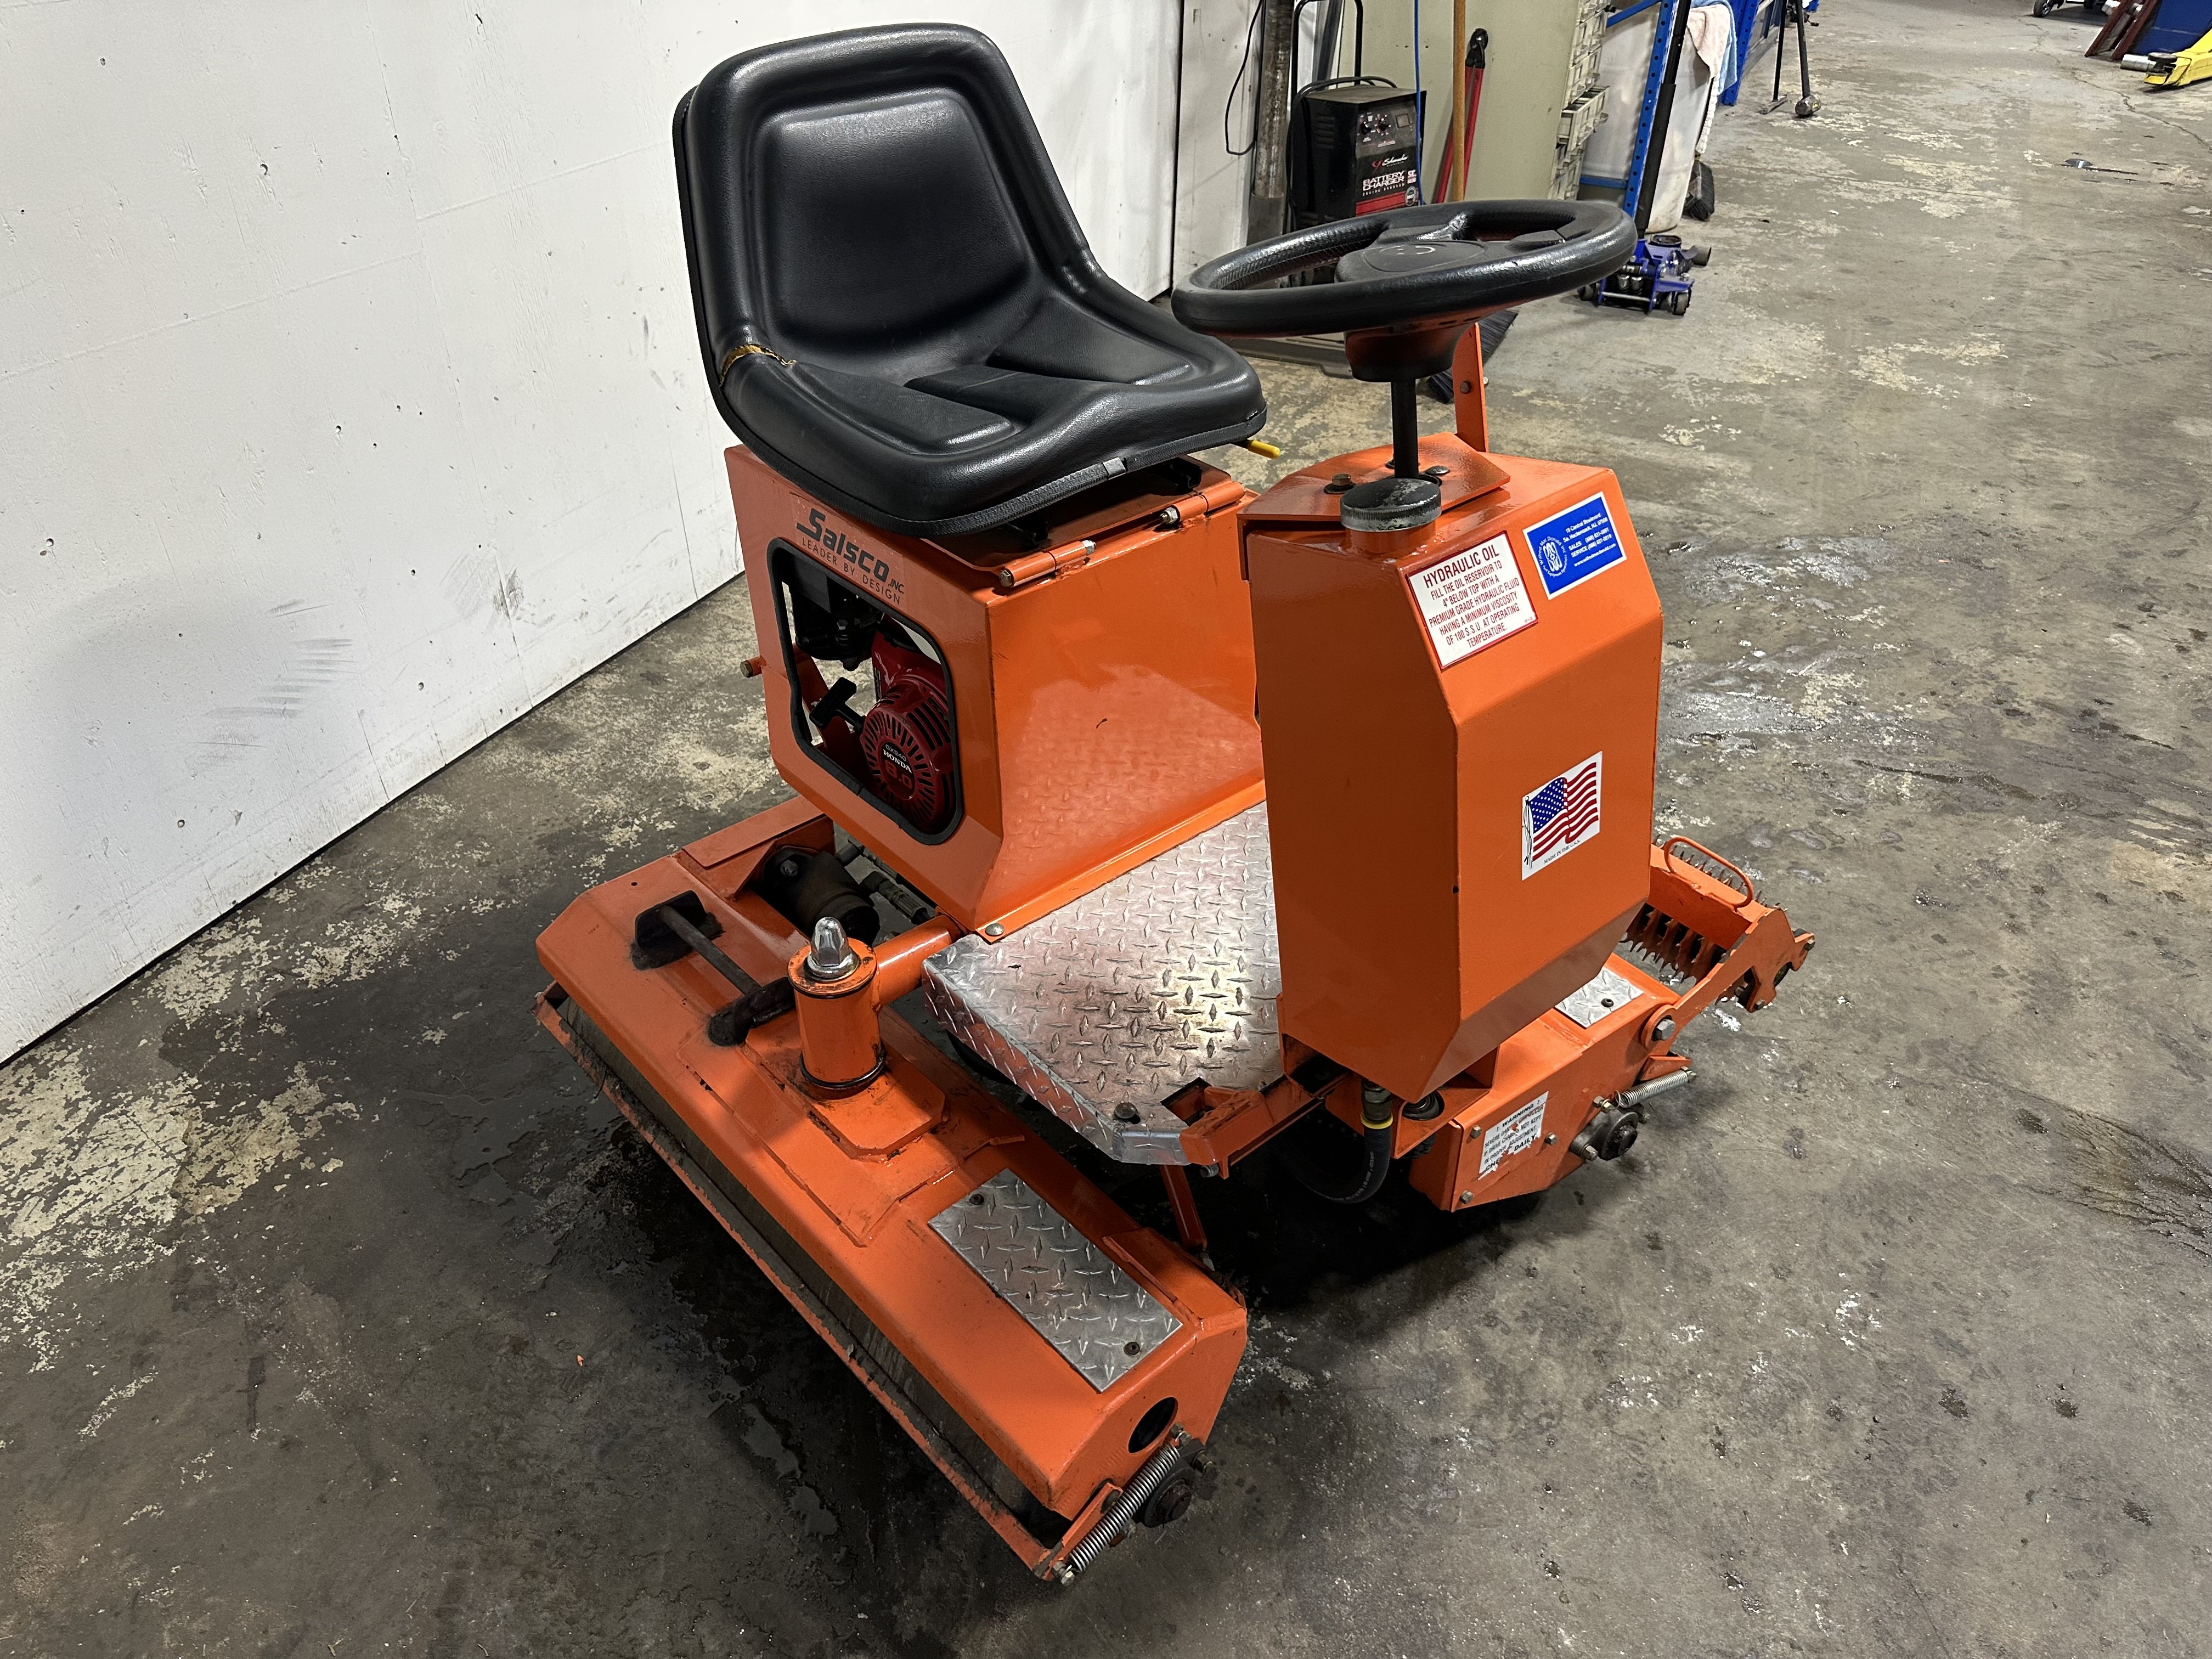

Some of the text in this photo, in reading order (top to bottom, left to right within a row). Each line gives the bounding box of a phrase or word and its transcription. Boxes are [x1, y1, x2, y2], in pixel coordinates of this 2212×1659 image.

[1363, 170, 1405, 186] BATTERY
[1363, 176, 1405, 191] CHARGER
[796, 508, 890, 583] Salsco
[1568, 540, 1582, 551] SALES
[1571, 545, 1588, 557] SERVICE
[802, 537, 900, 605] LEADER BY DESIGN
[1423, 544, 1499, 588] HYDRAULIC OIL
[1430, 560, 1502, 600] FILL THE OIL RESERVOIR TO
[1449, 589, 1469, 605] BELOW
[1469, 583, 1479, 595] TOP
[1480, 576, 1495, 590] WITH
[1495, 574, 1500, 583] A
[1429, 577, 1520, 628] PREMIUM GRADE HYDRAULIC FLUID
[1439, 591, 1518, 636] HAVING A MINIMUM VISCOSITY
[1446, 635, 1454, 646] OF
[1454, 629, 1465, 641] 100
[1483, 617, 1491, 628] AT
[1491, 603, 1520, 624] OPERATING
[1466, 623, 1508, 648] TEMPERATURE.
[883, 749, 912, 773] HONDA
[1544, 854, 1556, 864] MADE
[1502, 1103, 1534, 1127] WARNING
[1485, 1133, 1500, 1148] SEVERE
[1488, 1140, 1501, 1154] DRIVE
[1520, 1120, 1530, 1130] NOT
[1531, 1114, 1542, 1125] KEPT
[1514, 1134, 1536, 1151] DAILY
[1489, 1145, 1506, 1161] PROPER
